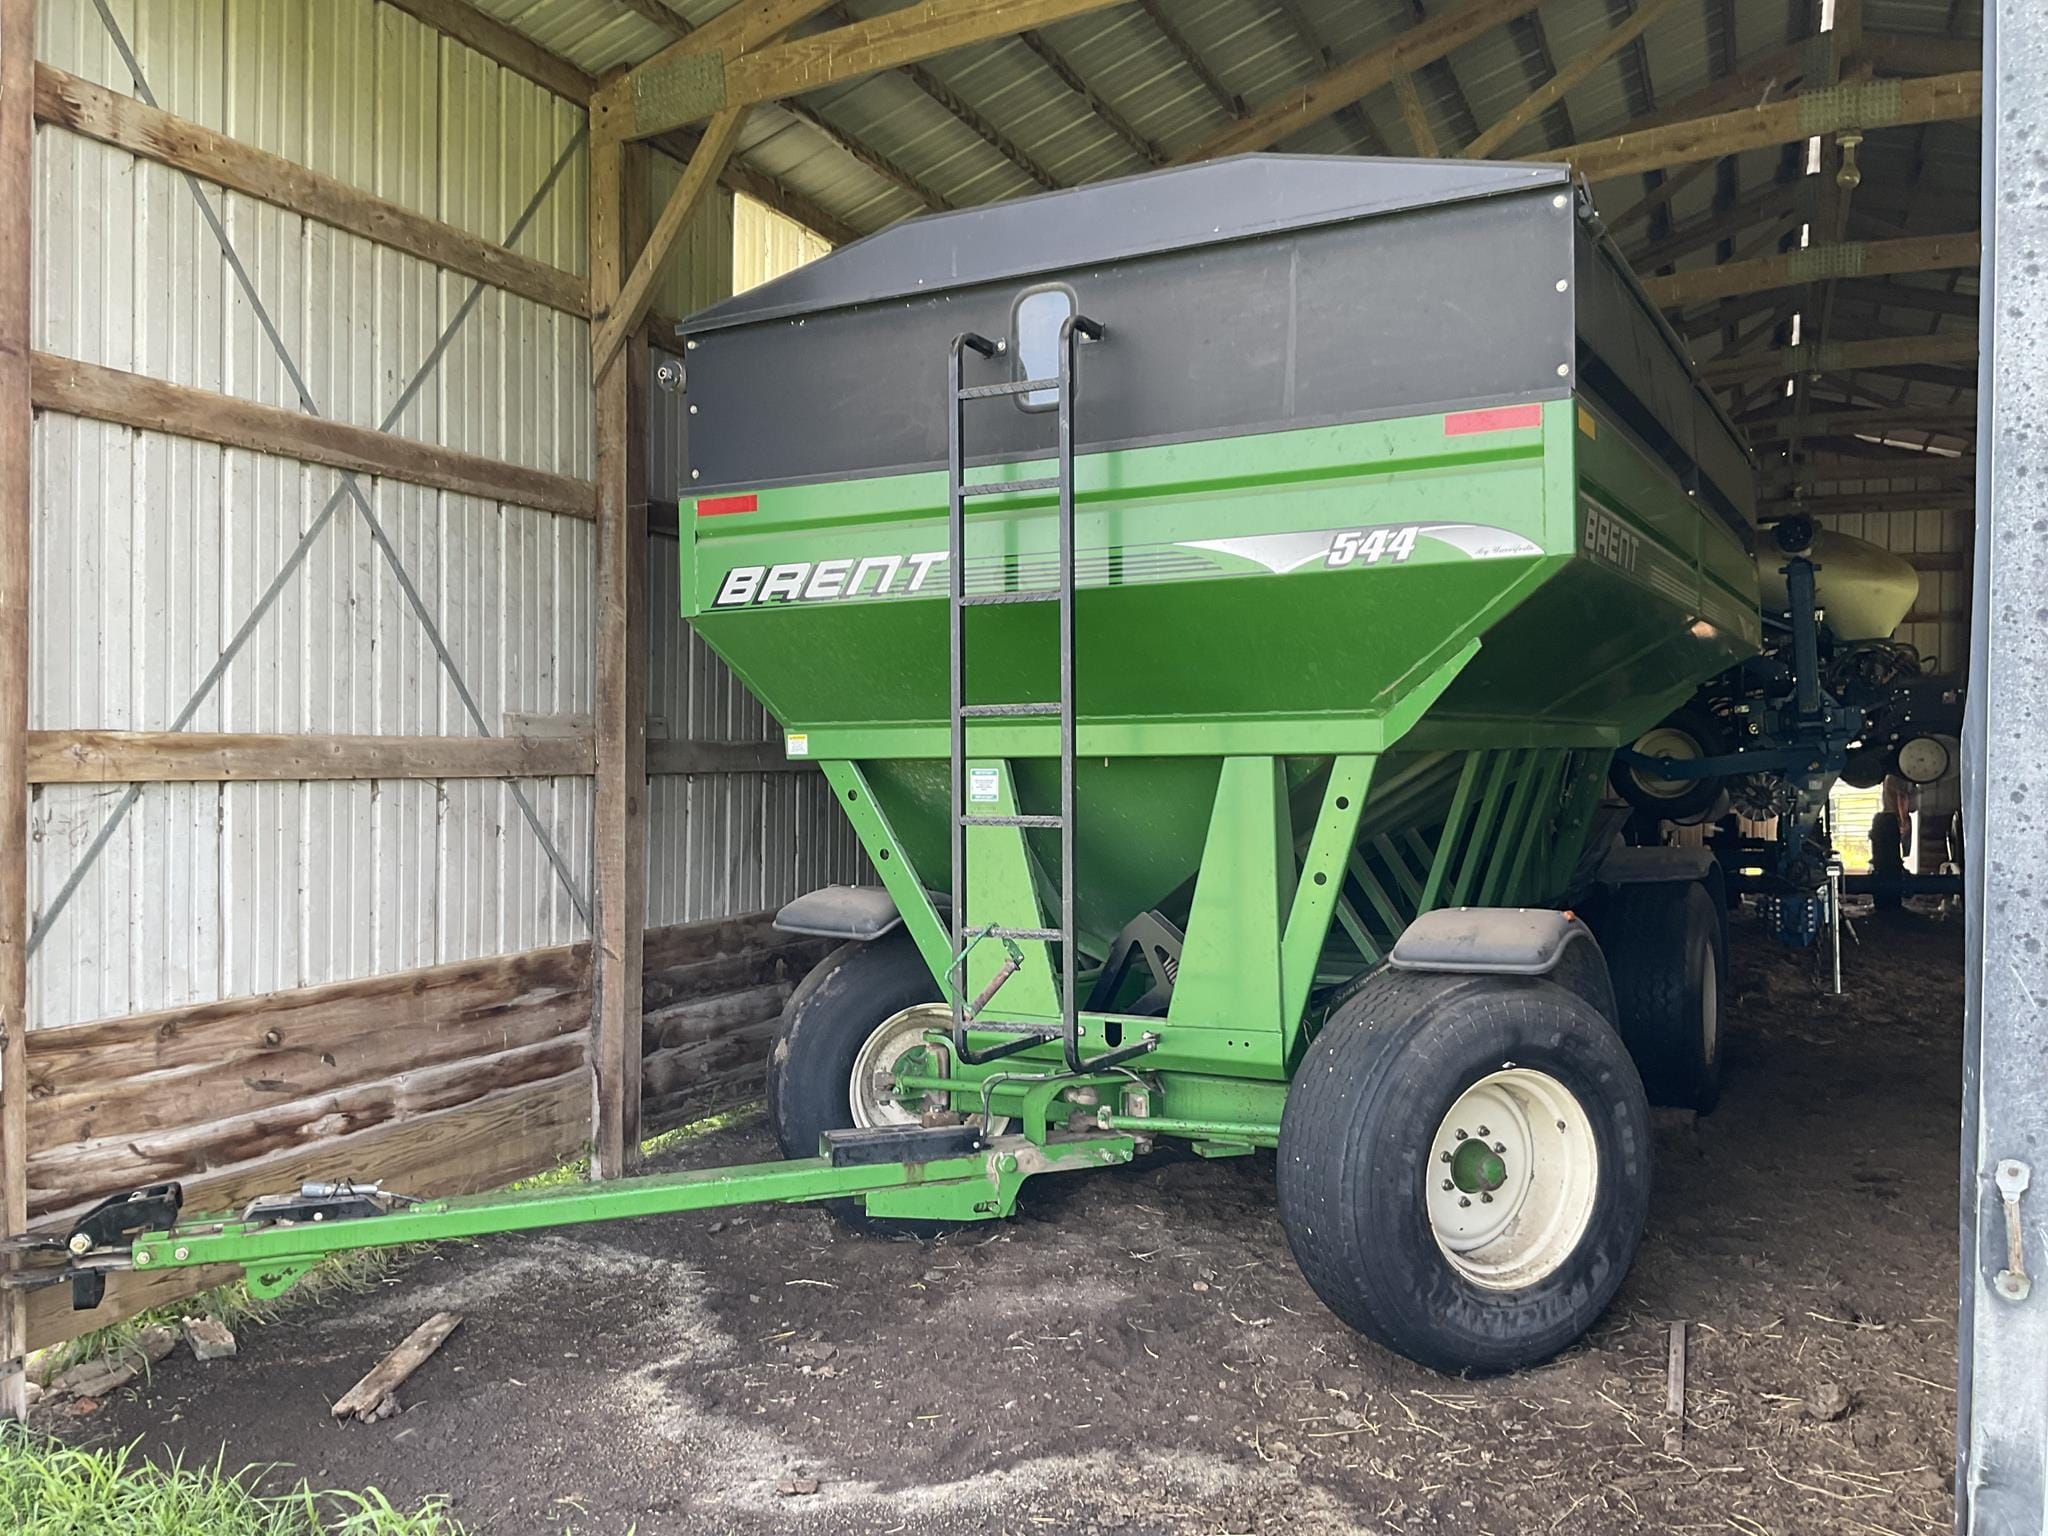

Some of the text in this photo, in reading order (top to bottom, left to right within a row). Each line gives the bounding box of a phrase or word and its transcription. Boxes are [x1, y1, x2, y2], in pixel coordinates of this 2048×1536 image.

[1325, 526, 1420, 568] 544
[1584, 507, 1640, 573] BRENT
[711, 550, 950, 608] BRENT
